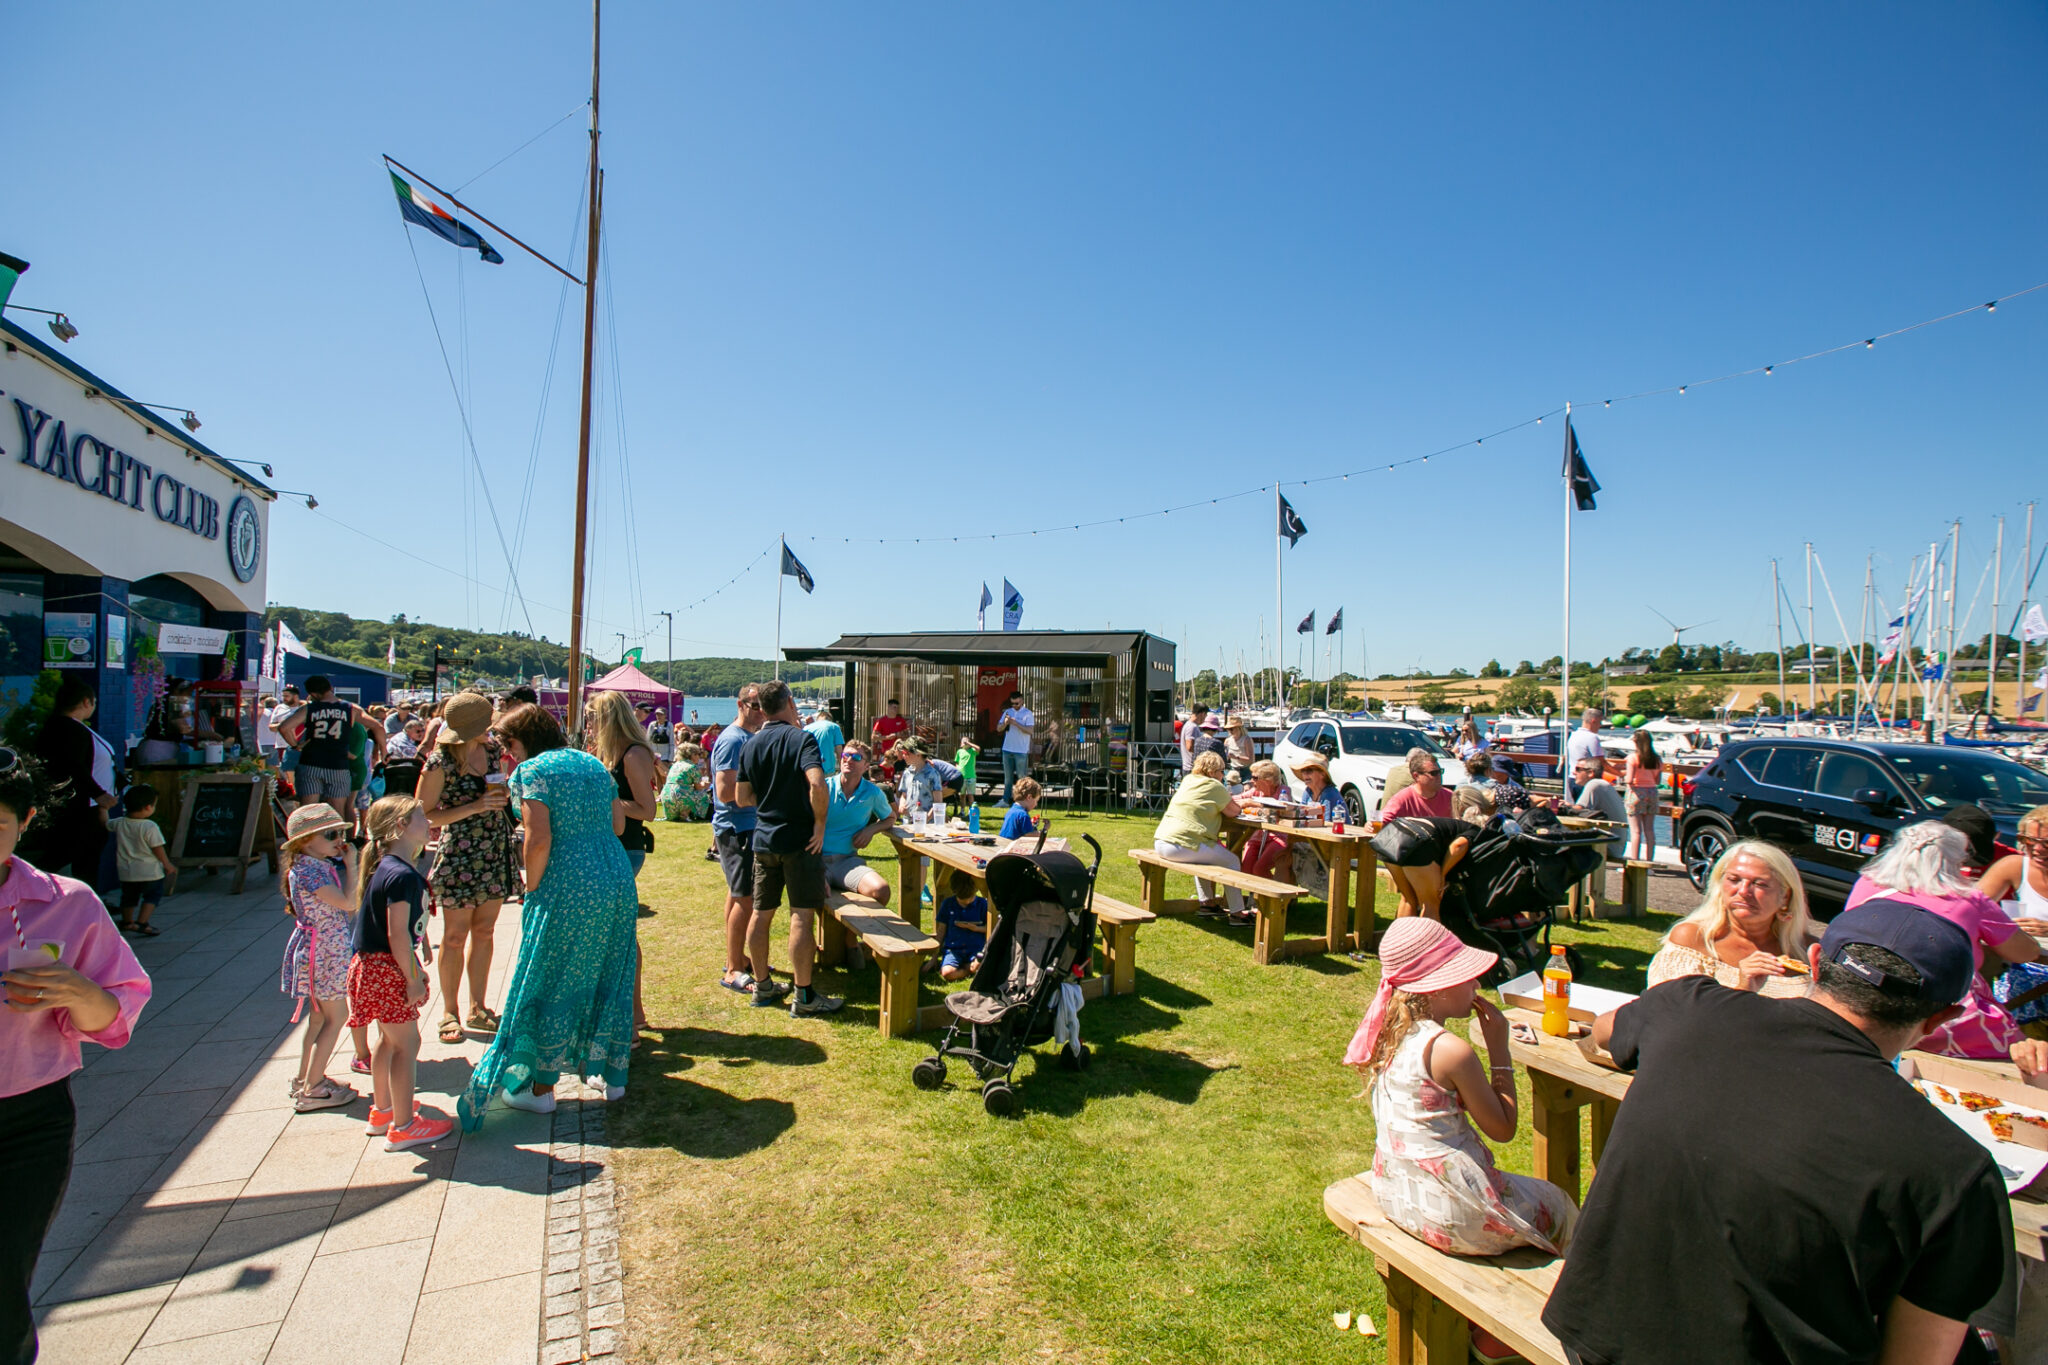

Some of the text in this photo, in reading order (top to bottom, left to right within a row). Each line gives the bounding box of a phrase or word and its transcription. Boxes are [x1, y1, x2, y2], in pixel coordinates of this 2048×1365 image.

[14, 398, 152, 512] YACHT
[154, 473, 220, 540] CLUB
[1153, 661, 1174, 673] VOLVO
[979, 672, 1006, 686] Red
[312, 708, 347, 722] MAMBA
[314, 721, 342, 739] 24
[1815, 824, 1836, 833] VOLVO
